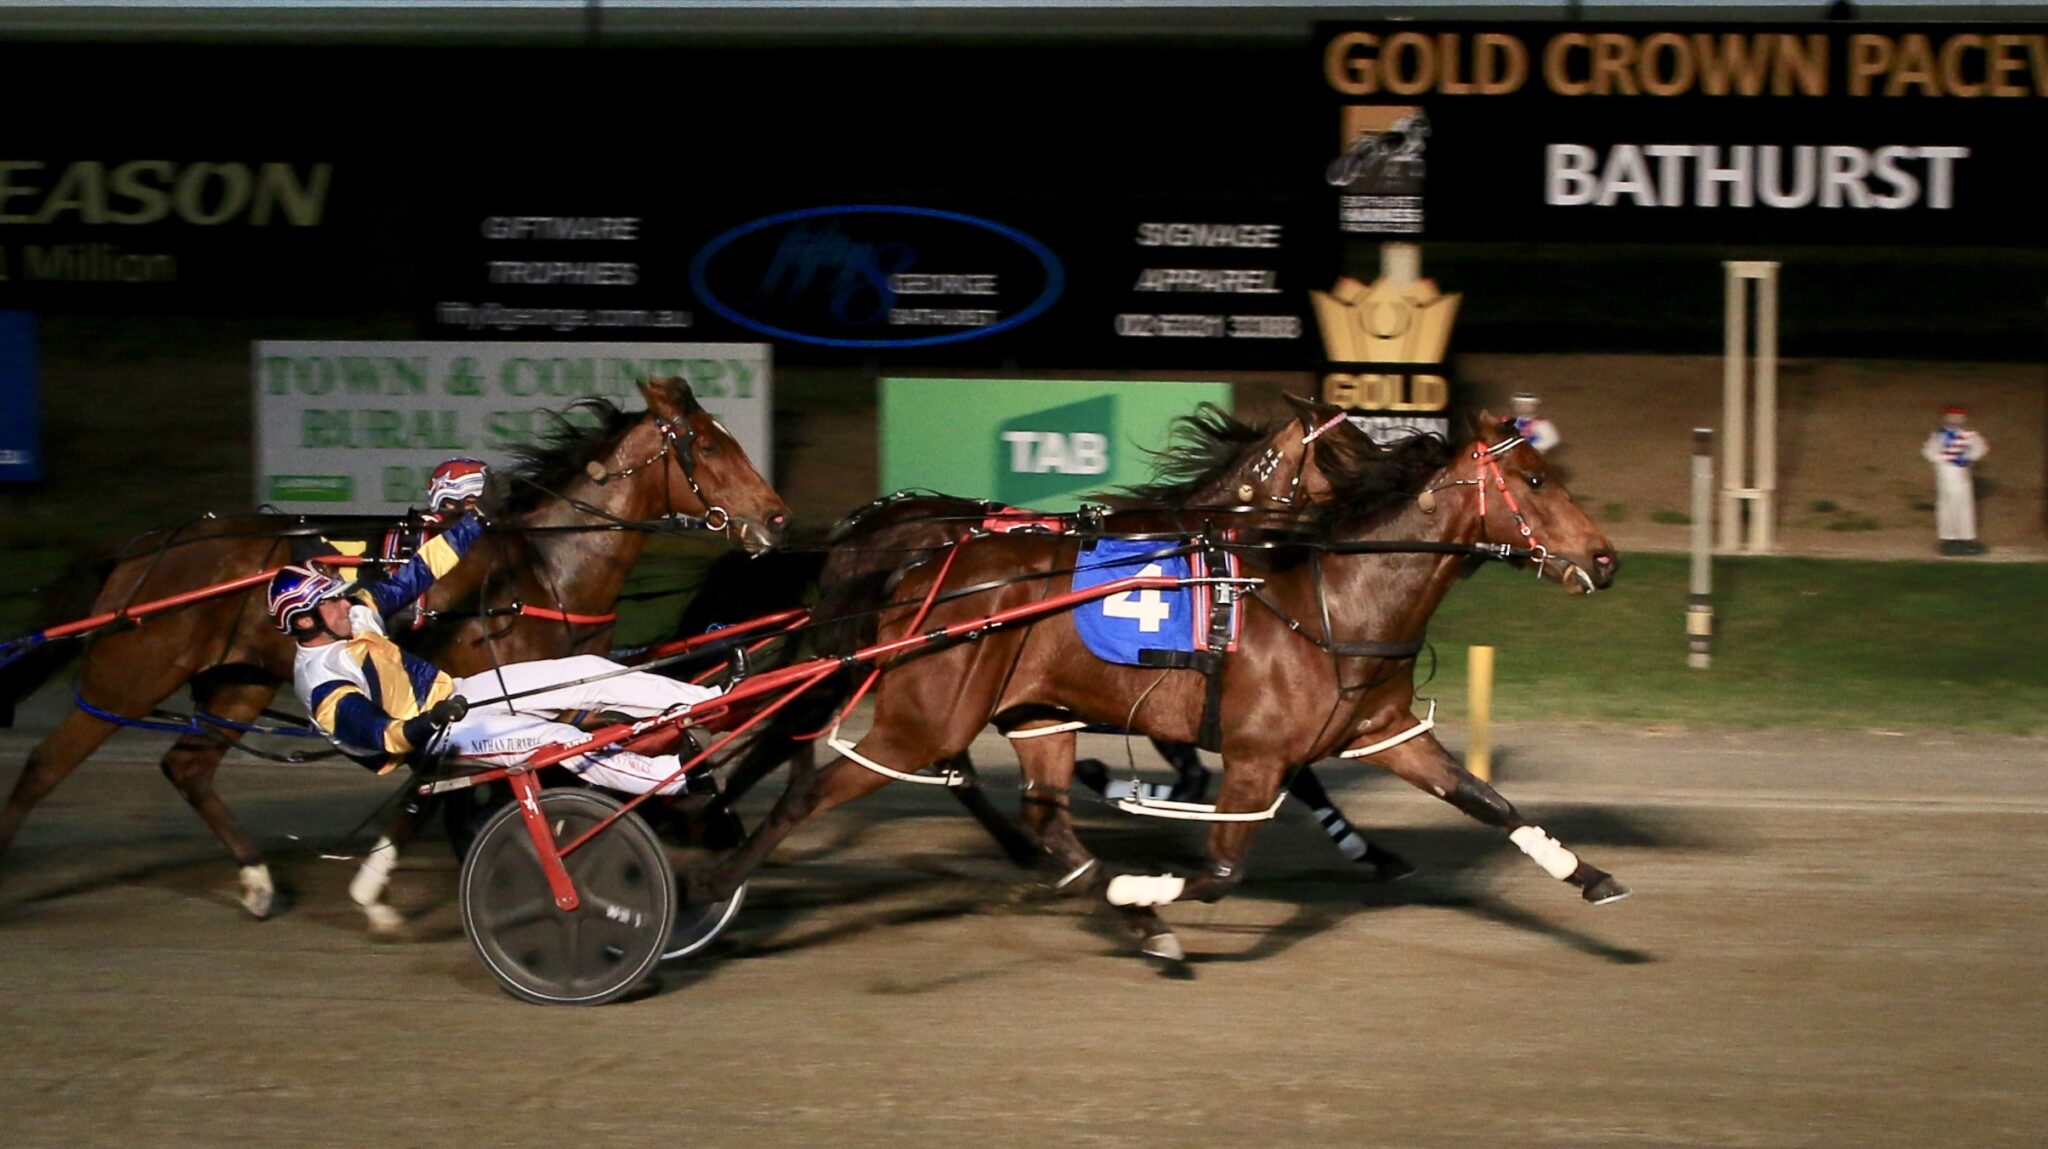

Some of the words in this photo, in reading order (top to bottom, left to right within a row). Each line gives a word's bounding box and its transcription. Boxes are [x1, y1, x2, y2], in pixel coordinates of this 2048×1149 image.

[1324, 31, 1529, 95] GOLD
[1543, 32, 1829, 97] CROWN
[0, 160, 335, 226] EASON
[1545, 144, 1970, 209] BATHURST
[480, 215, 642, 240] GIFTWARE
[1135, 221, 1285, 248] SIGNAGE
[22, 241, 177, 283] Million
[484, 260, 641, 286] TROPHIES
[1133, 267, 1283, 294] APPAREL
[887, 273, 1000, 295] GEORGE
[264, 356, 429, 396] TOWN
[444, 356, 486, 396] &
[499, 357, 756, 398] COUNTRY
[1323, 373, 1449, 412] GOLD
[303, 408, 468, 449] RURAL
[1001, 430, 1108, 475] TAB
[1103, 563, 1170, 632] 4
[471, 738, 505, 752] NATHAN
